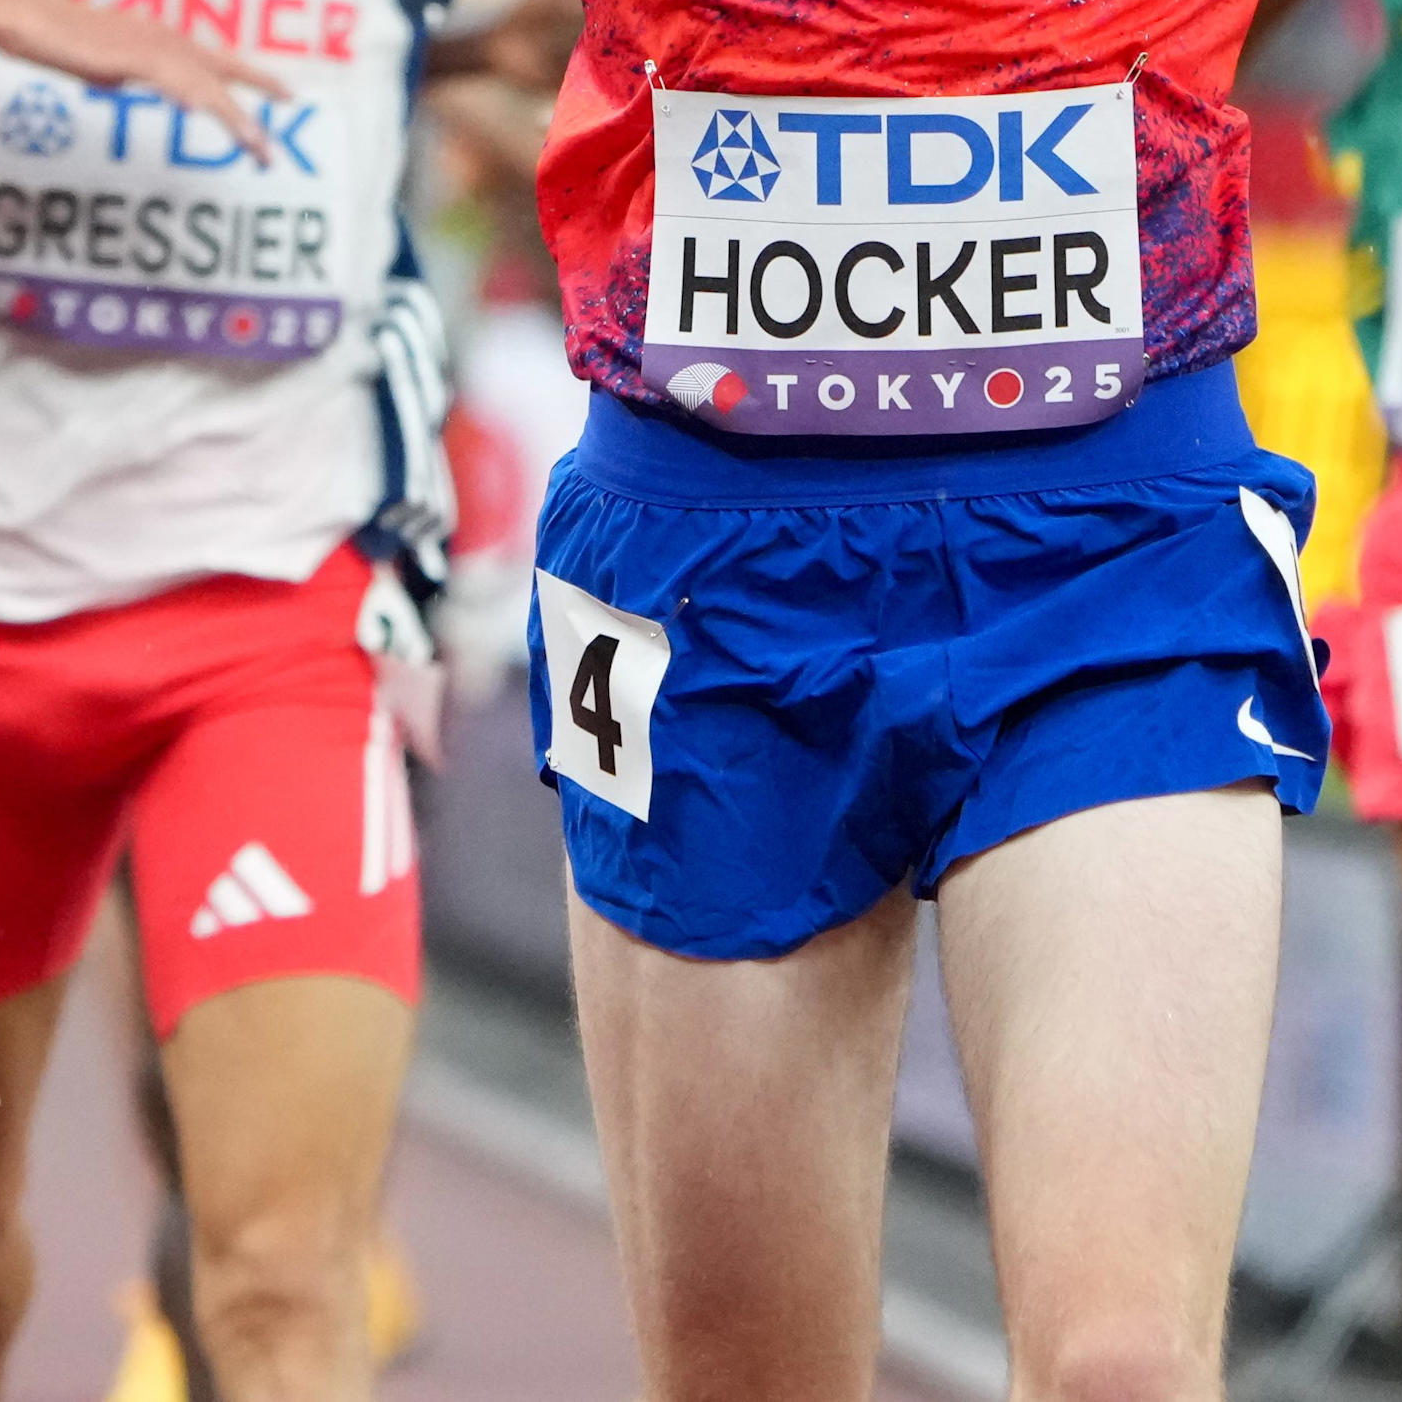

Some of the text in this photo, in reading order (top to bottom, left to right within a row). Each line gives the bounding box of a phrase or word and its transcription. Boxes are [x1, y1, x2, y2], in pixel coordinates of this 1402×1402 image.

[86, 78, 319, 176] TDK
[778, 103, 1100, 206] TDK
[678, 230, 1113, 340] HOCKER
[569, 634, 622, 776] 4
